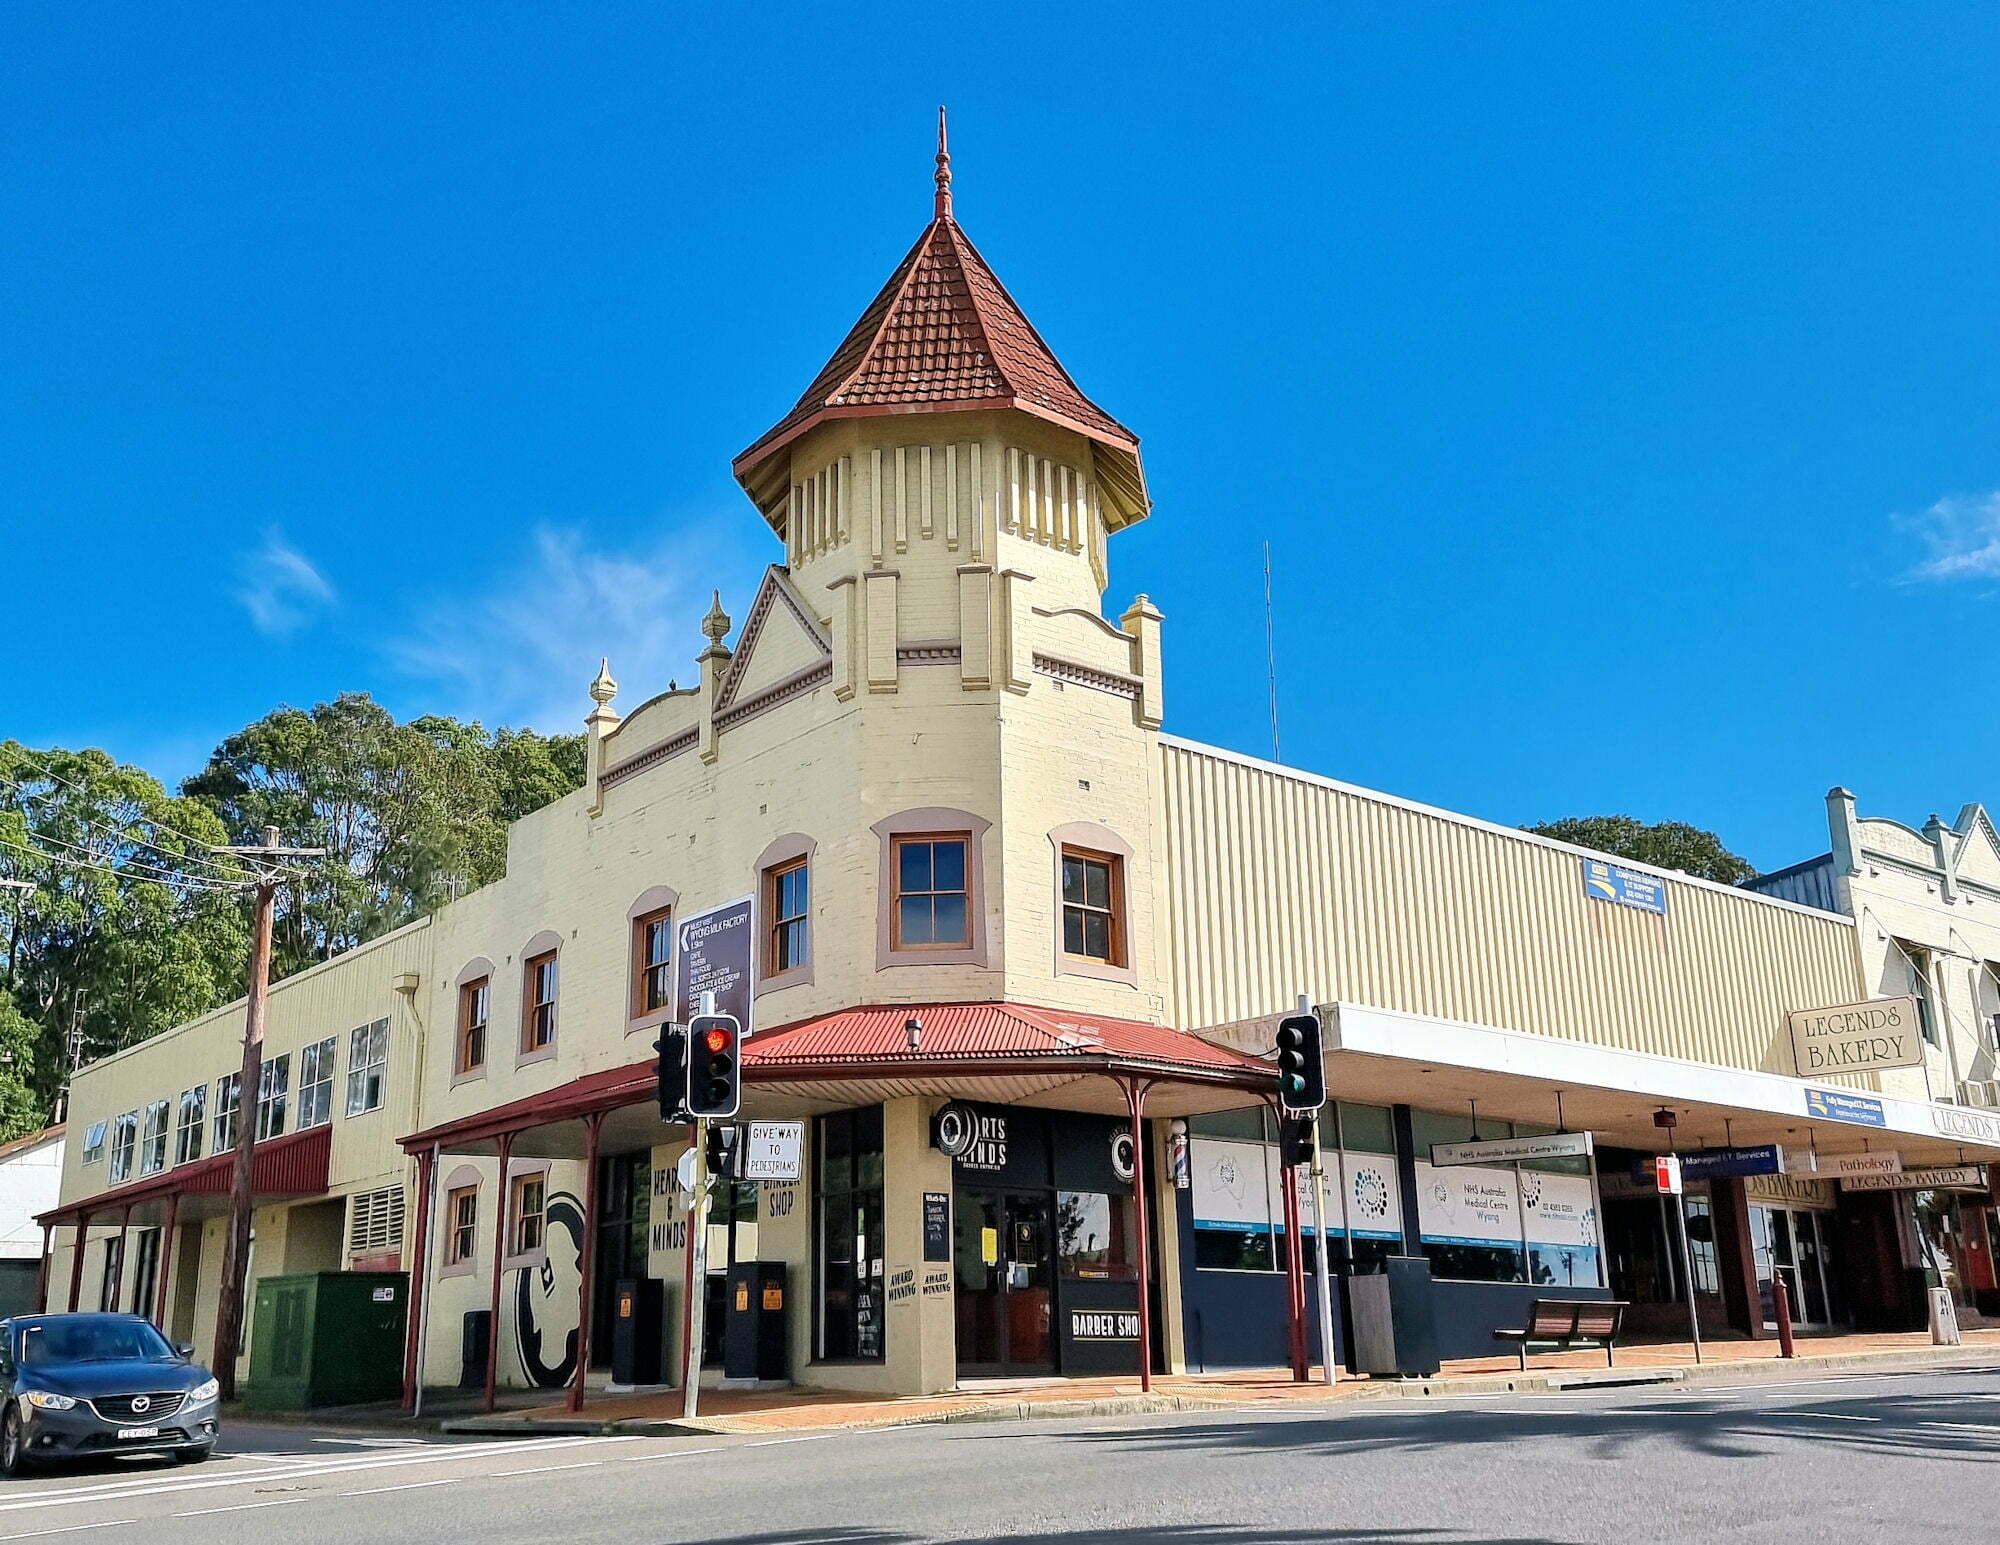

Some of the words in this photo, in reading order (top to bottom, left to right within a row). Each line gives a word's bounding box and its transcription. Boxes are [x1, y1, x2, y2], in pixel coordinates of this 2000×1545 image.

[1803, 1006, 1901, 1038] LEGENDS
[1808, 1035, 1905, 1068] BAKERY
[1941, 1110, 1993, 1139] LEGENDS
[753, 1128, 773, 1140] GIVE
[778, 1128, 799, 1140] WAY
[769, 1145, 781, 1156] TO
[1736, 1151, 1771, 1161] Services
[750, 1160, 797, 1173] PEDESTRIANS
[1839, 1158, 1895, 1173] Pathology
[1850, 1173, 1912, 1188] LEGENDS
[1916, 1170, 1968, 1185] BAKERY
[1464, 1183, 1479, 1195] NHS
[667, 1196, 673, 1220] &
[770, 1191, 794, 1217] SHOP
[1465, 1197, 1488, 1209] Medical
[1490, 1199, 1509, 1211] Centre
[1476, 1210, 1500, 1224] Wyong
[653, 1221, 687, 1251] MINDS
[890, 1269, 914, 1287] AWARD
[924, 1273, 948, 1285] AWARD
[888, 1282, 916, 1302] WINNING
[922, 1282, 951, 1295] WINNING
[1073, 1315, 1114, 1336] BARBER
[1118, 1315, 1142, 1337] SHO
